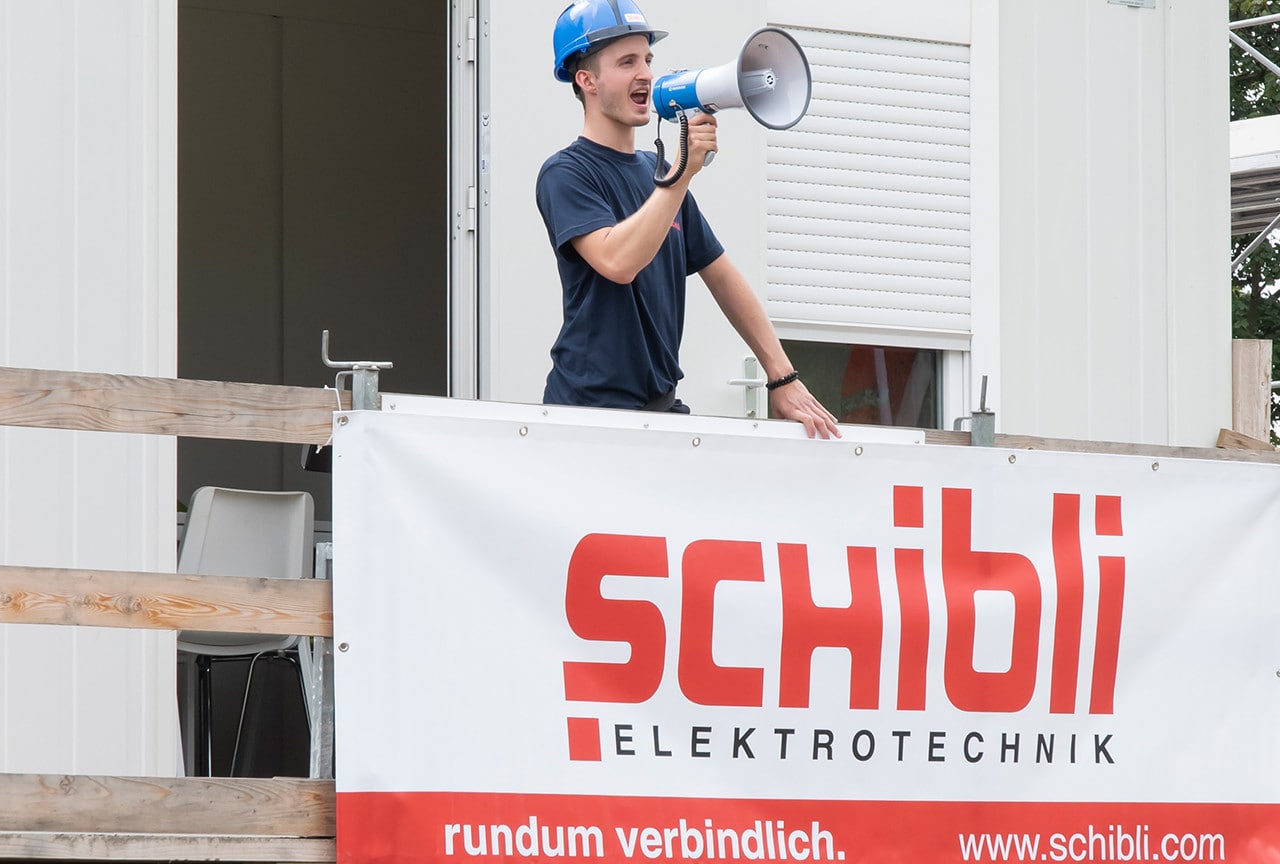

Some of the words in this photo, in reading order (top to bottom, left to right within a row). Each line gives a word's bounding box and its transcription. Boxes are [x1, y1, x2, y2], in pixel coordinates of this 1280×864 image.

[614, 724, 1114, 764] ELEKTROTECHNIK
[444, 815, 605, 858] rundum
[614, 818, 846, 861] verbindlich.
[958, 824, 1225, 862] www.schibli.com
